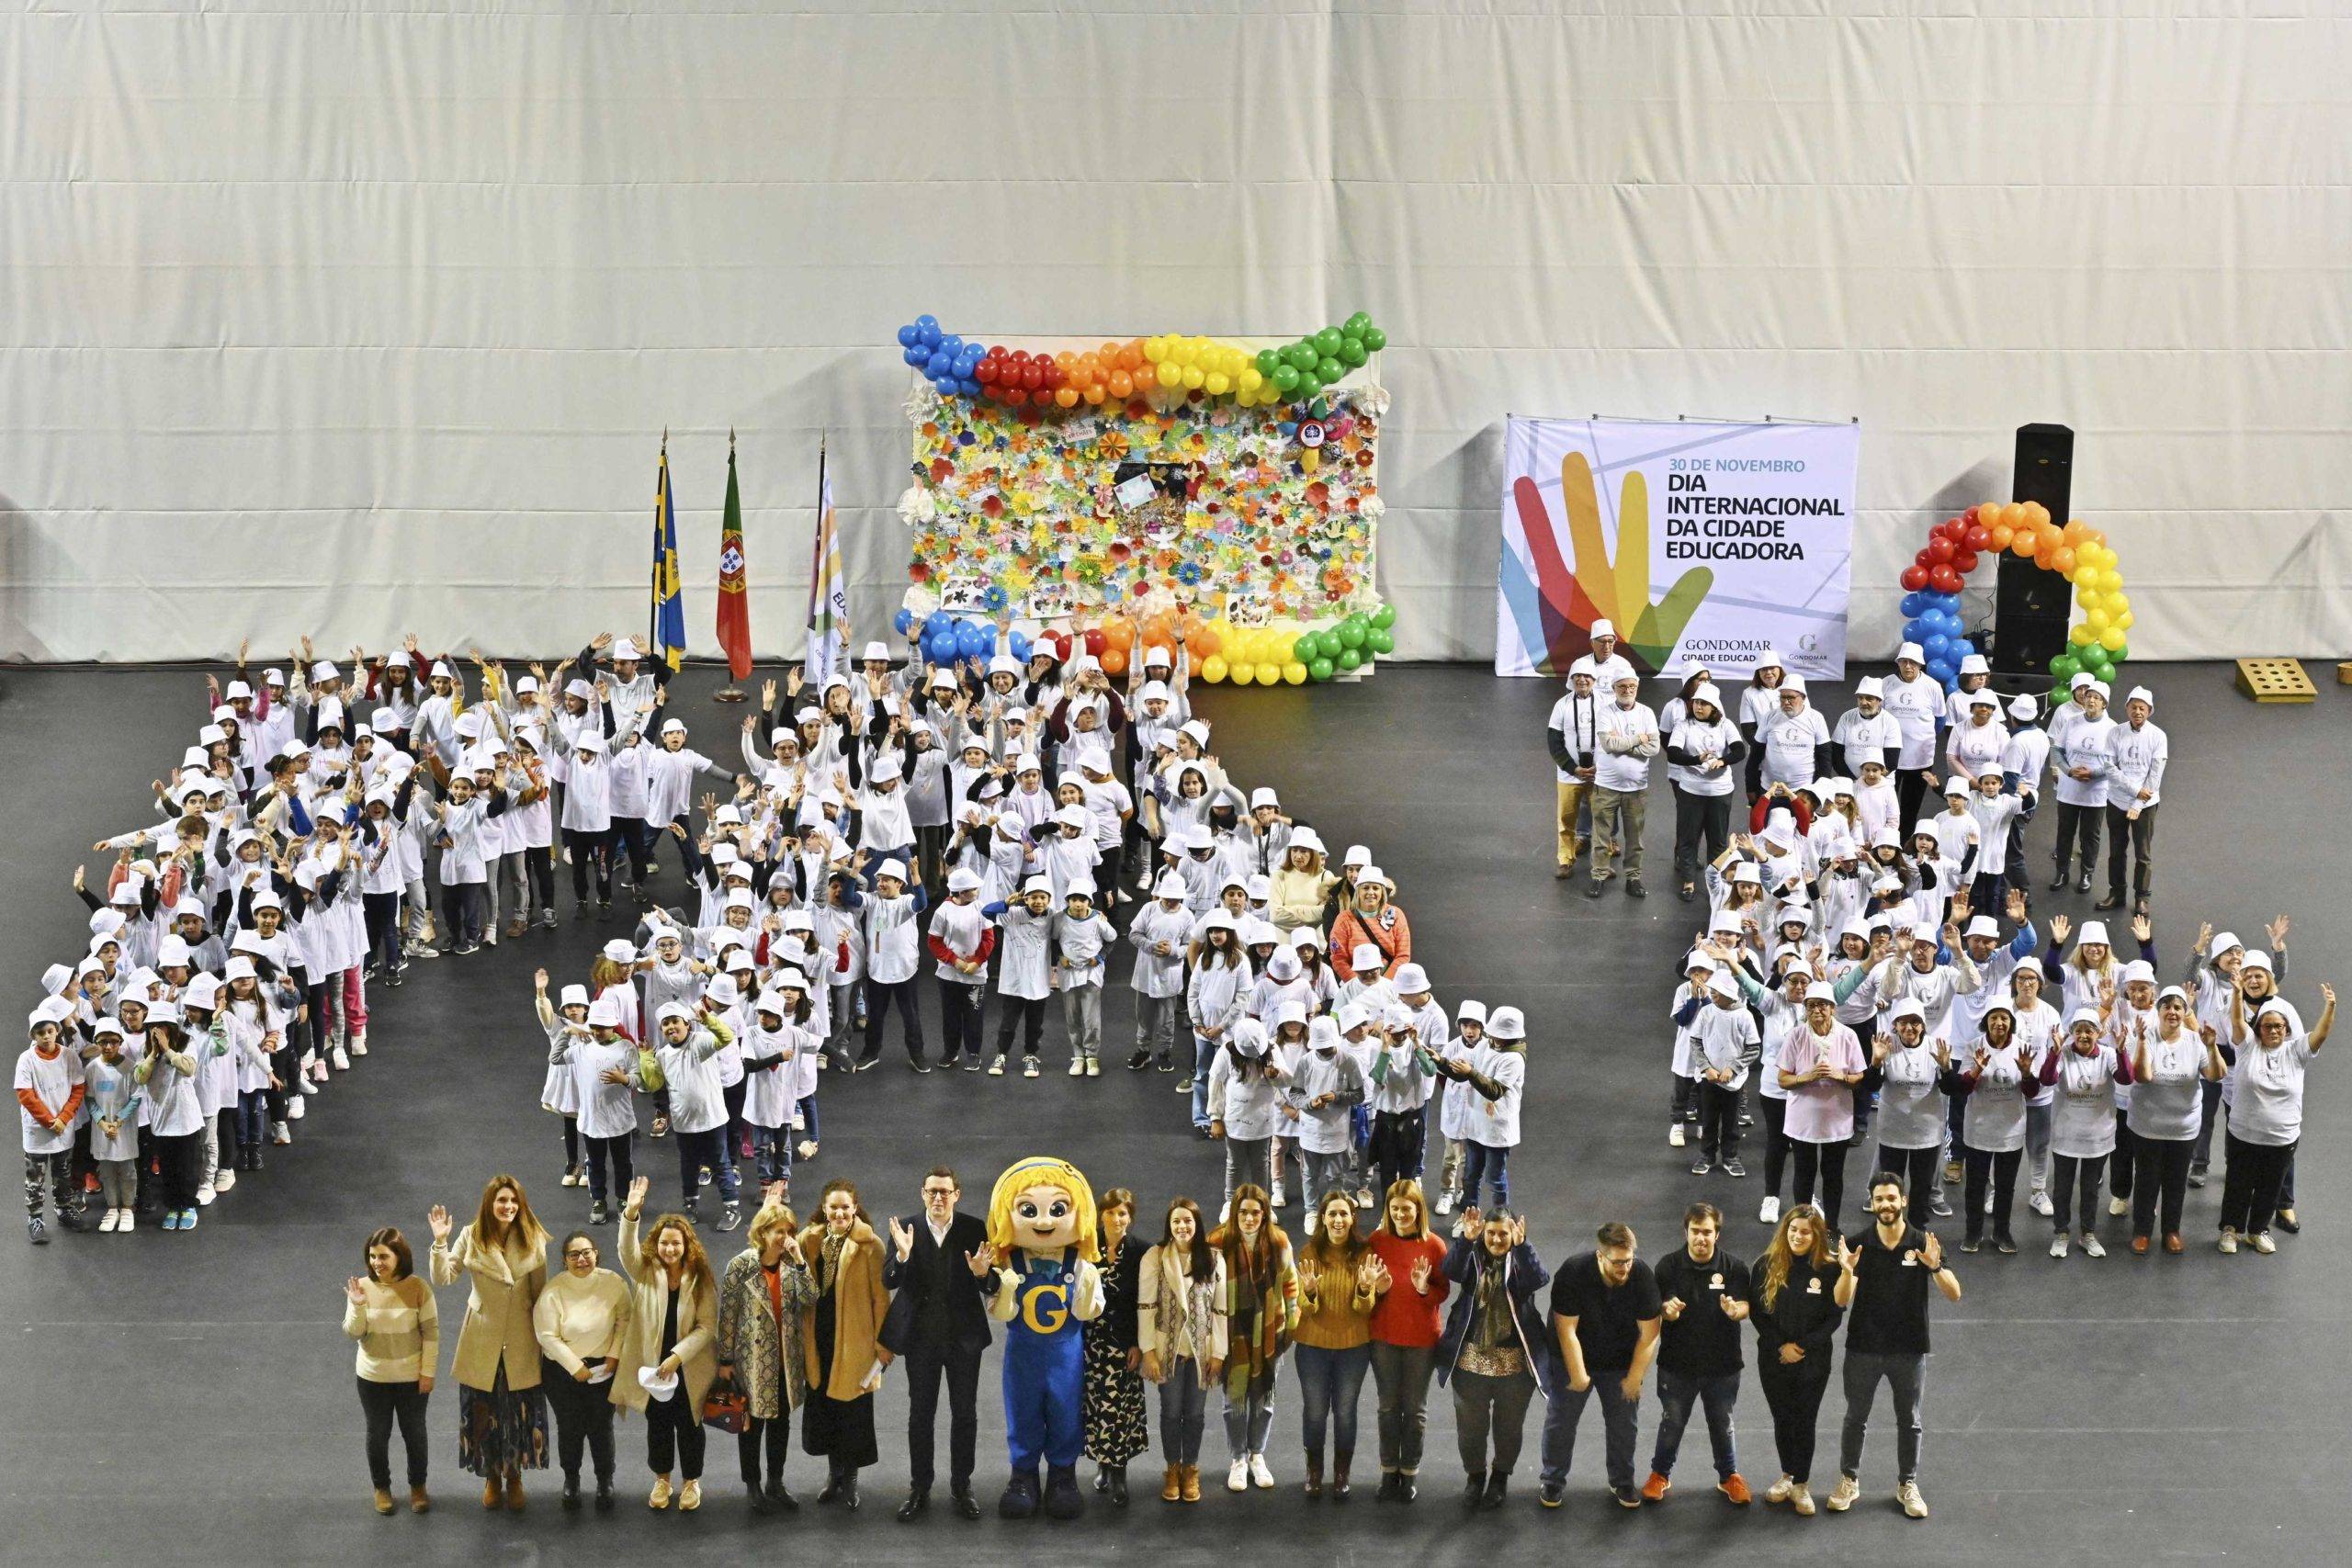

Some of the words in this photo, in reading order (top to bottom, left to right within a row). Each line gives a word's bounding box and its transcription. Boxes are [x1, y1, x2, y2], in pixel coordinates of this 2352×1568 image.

[1669, 458, 1687, 471] 30
[1690, 458, 1712, 472] DE
[1715, 459, 1805, 473] NOVEMBRO
[1668, 474, 1707, 491] DIA
[1668, 496, 1845, 516] INTERNACIONAL
[1667, 519, 1699, 536] DA
[1703, 519, 1785, 537] CIDADE
[1666, 541, 1804, 560] EDUCADORA
[1685, 638, 1771, 651] GONDOMAR
[1681, 653, 1715, 661] CIDADE
[1718, 654, 1757, 662] EDUCAD
[1022, 1284, 1069, 1336] G
